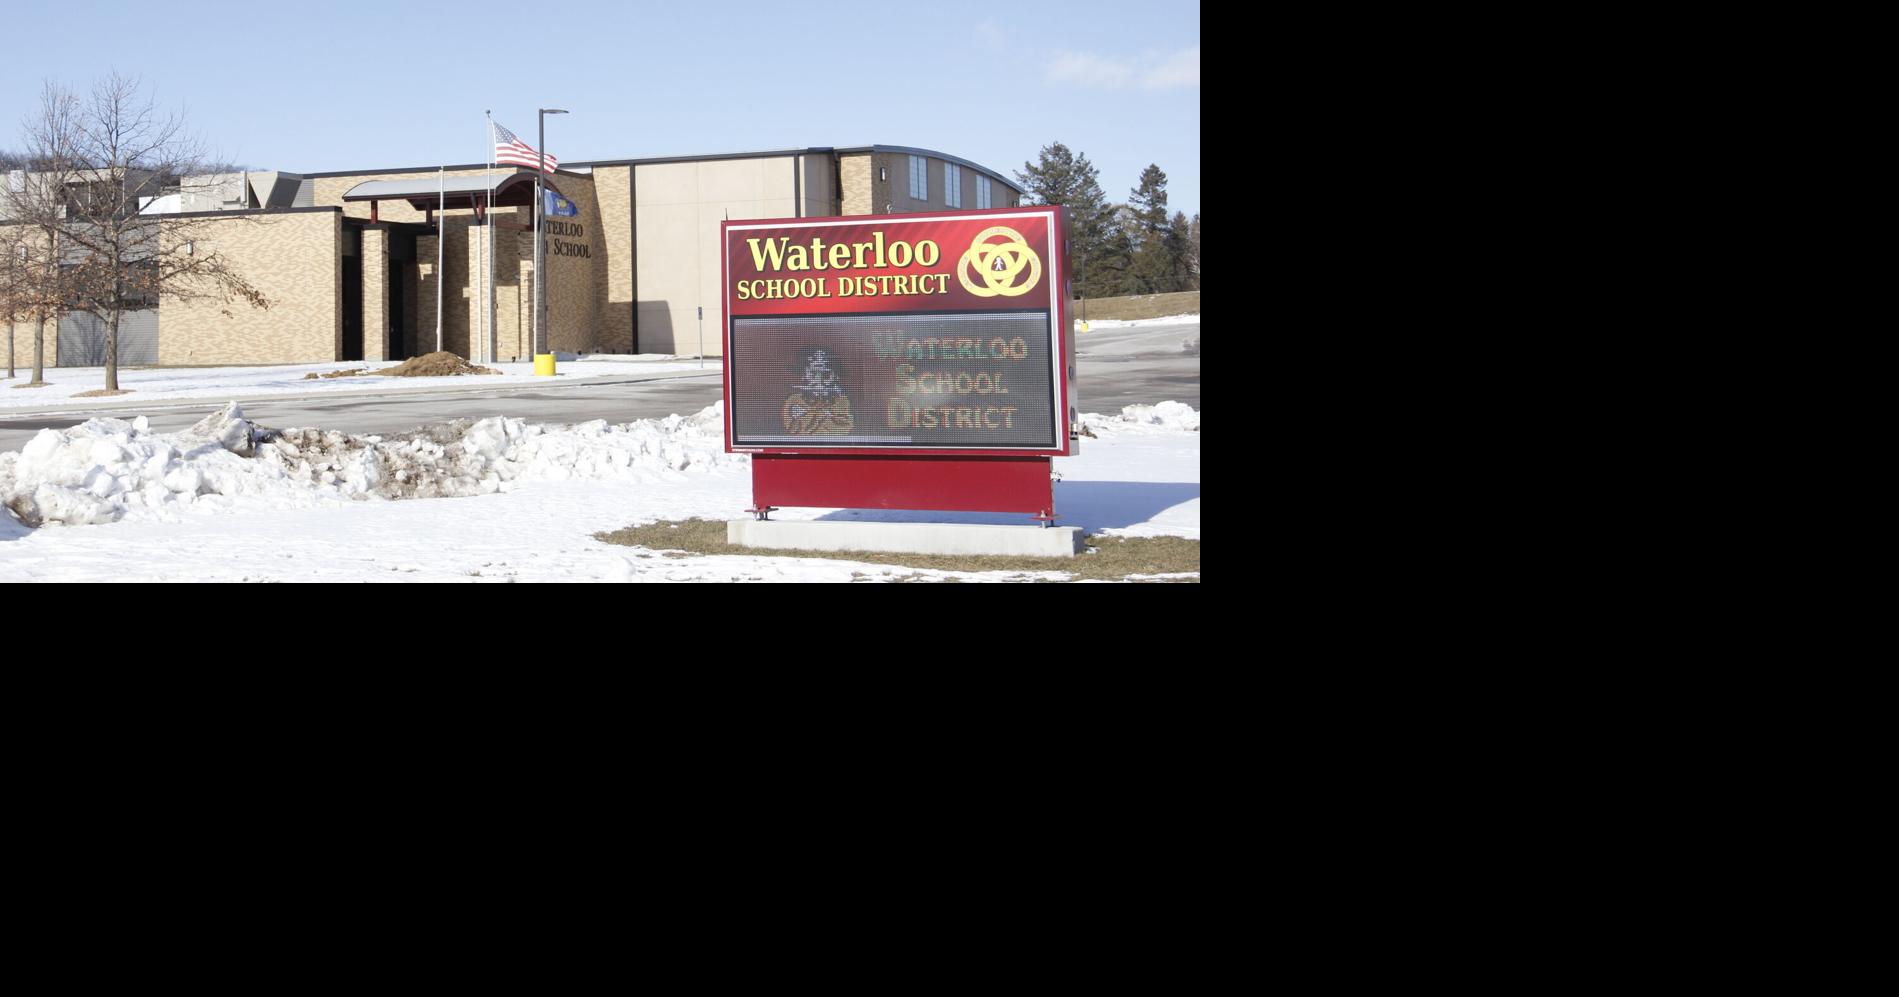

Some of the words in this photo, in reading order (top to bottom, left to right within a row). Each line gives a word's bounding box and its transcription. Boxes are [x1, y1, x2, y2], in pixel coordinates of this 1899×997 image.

[546, 220, 583, 237] TERLOO
[554, 238, 591, 258] SCHOOL
[746, 232, 939, 272] Waterloo
[737, 278, 831, 301] SCHOOL
[838, 274, 950, 297] DISTRICT
[872, 329, 1029, 361] WATERLOO
[895, 364, 1009, 395] SCHOOL
[887, 397, 1018, 430] DISTRICT
